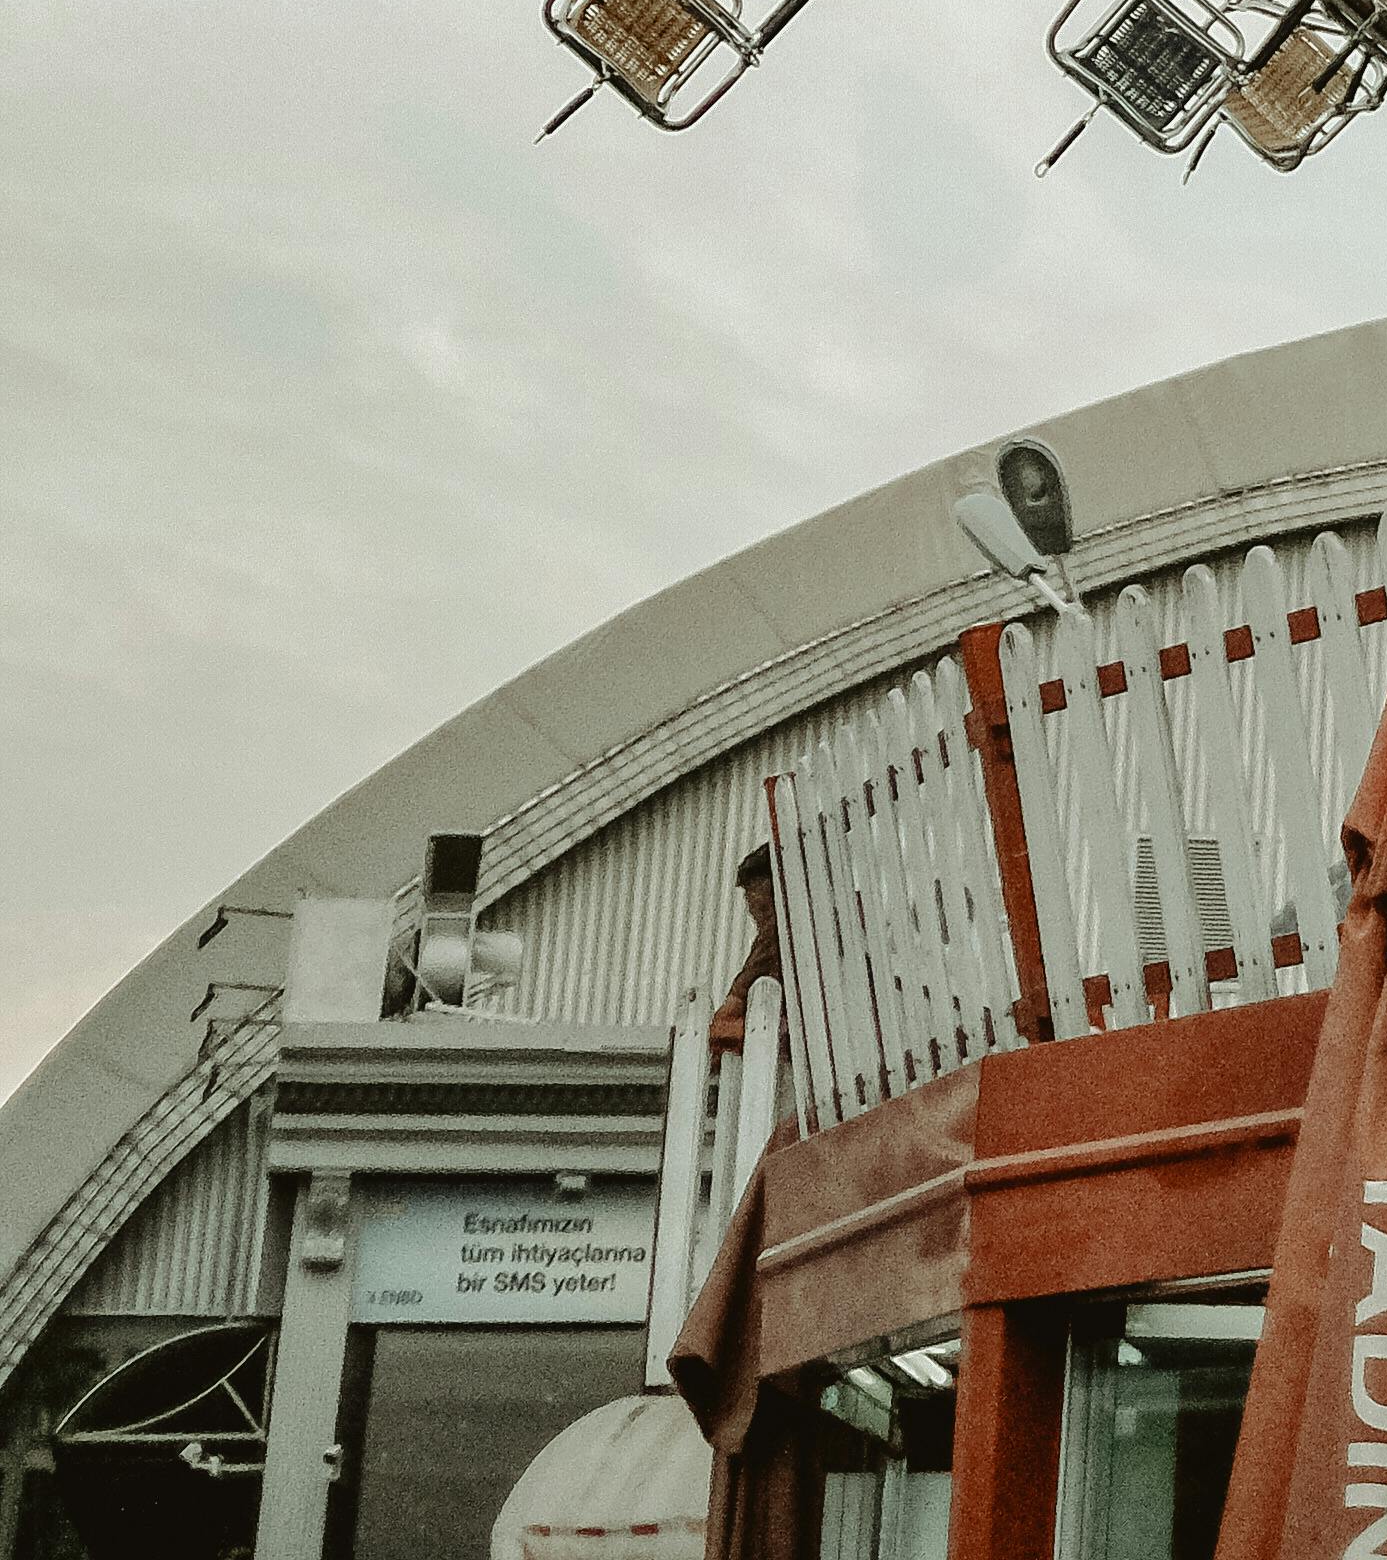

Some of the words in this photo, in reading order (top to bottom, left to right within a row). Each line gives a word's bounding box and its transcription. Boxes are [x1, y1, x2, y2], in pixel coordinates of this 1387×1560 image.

[460, 1243, 504, 1263] tüm
[456, 1272, 487, 1293] bir
[493, 1271, 546, 1294] SMS
[553, 1273, 616, 1297] yeter!
